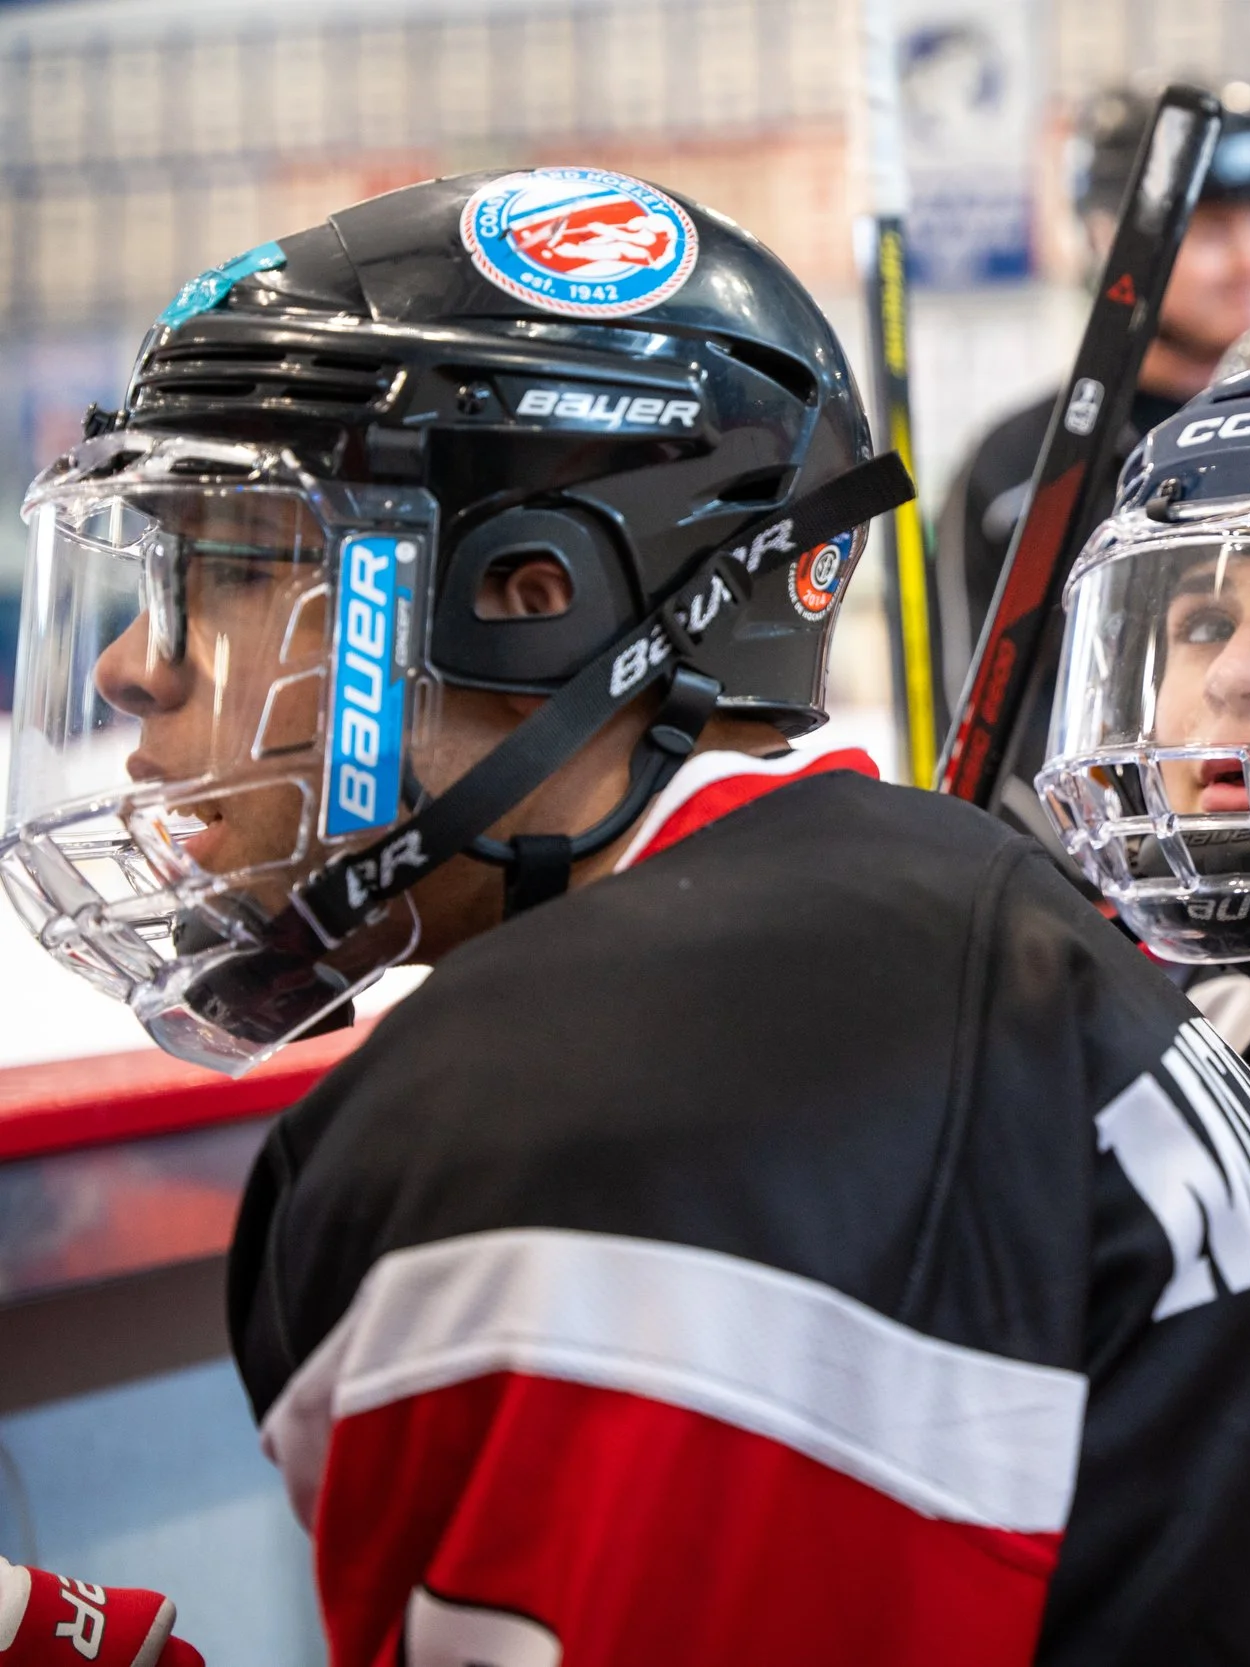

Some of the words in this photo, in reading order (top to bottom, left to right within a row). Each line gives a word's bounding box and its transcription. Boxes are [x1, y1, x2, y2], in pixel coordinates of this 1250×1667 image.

[520, 272, 556, 294] est.
[569, 284, 619, 301] 1942
[803, 589, 828, 608] 2014
[338, 544, 390, 823] BAUER
